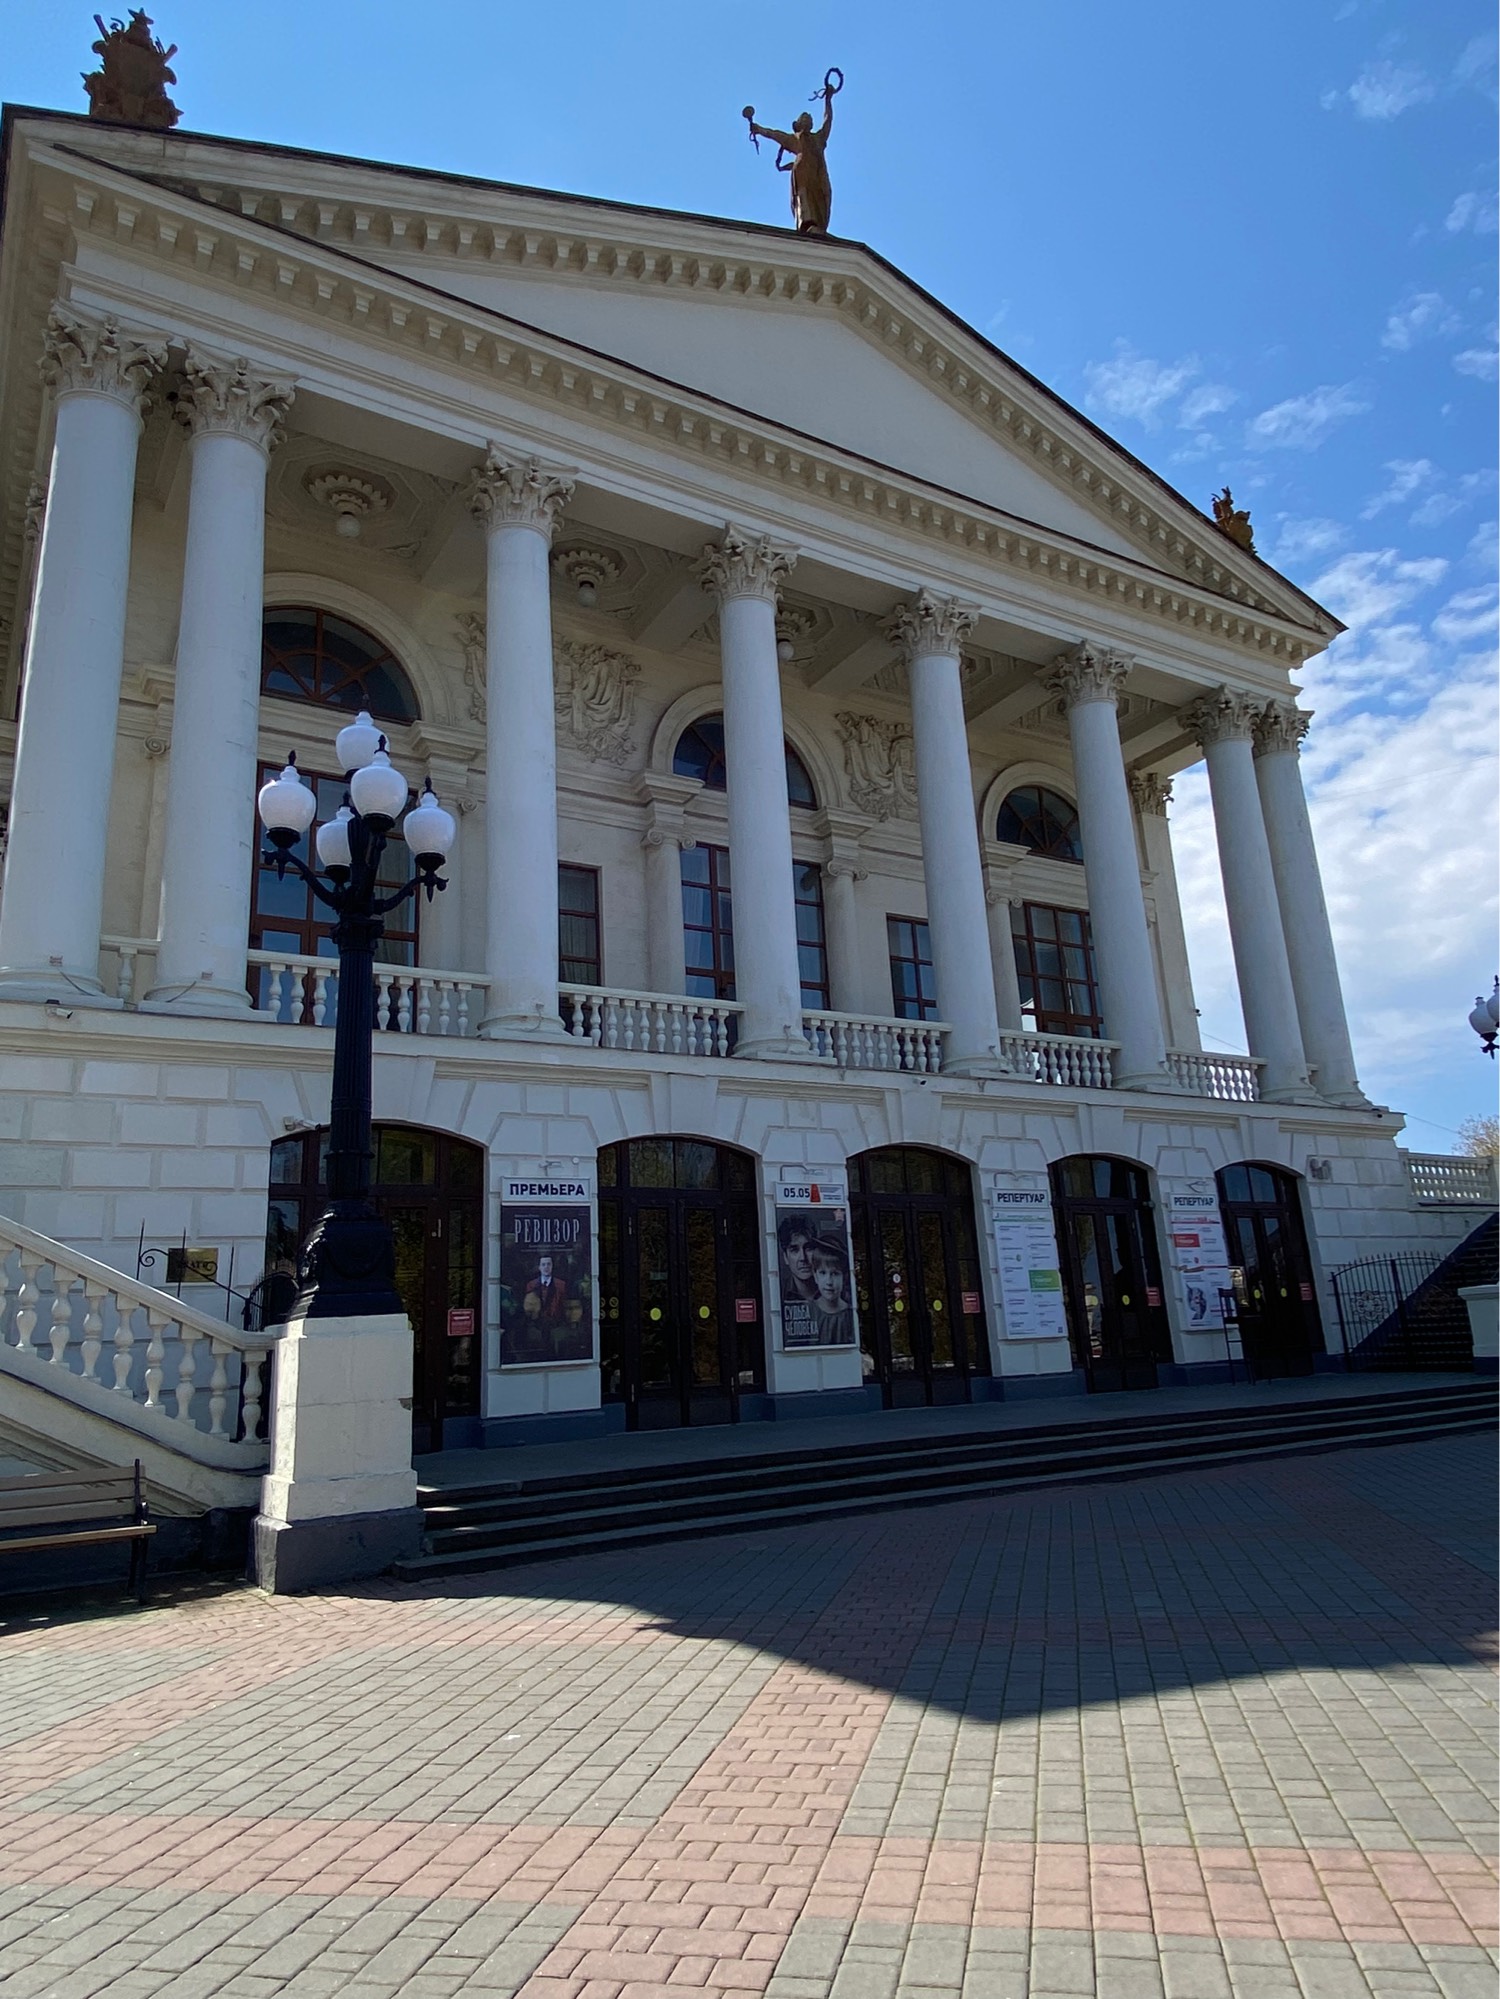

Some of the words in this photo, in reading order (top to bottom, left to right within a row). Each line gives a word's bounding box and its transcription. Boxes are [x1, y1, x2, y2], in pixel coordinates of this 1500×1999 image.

[510, 1184, 585, 1195] ПРЕМЬЕРА
[784, 1188, 810, 1198] 05.05
[997, 1193, 1045, 1203] РЕПЕРТУАР
[1174, 1197, 1214, 1206] РЕПЕРТУАР
[514, 1218, 580, 1243] РЕВИЗОР
[784, 1305, 811, 1320] СУДЬБА
[784, 1320, 819, 1336] ЧЕЛОВЕКА
